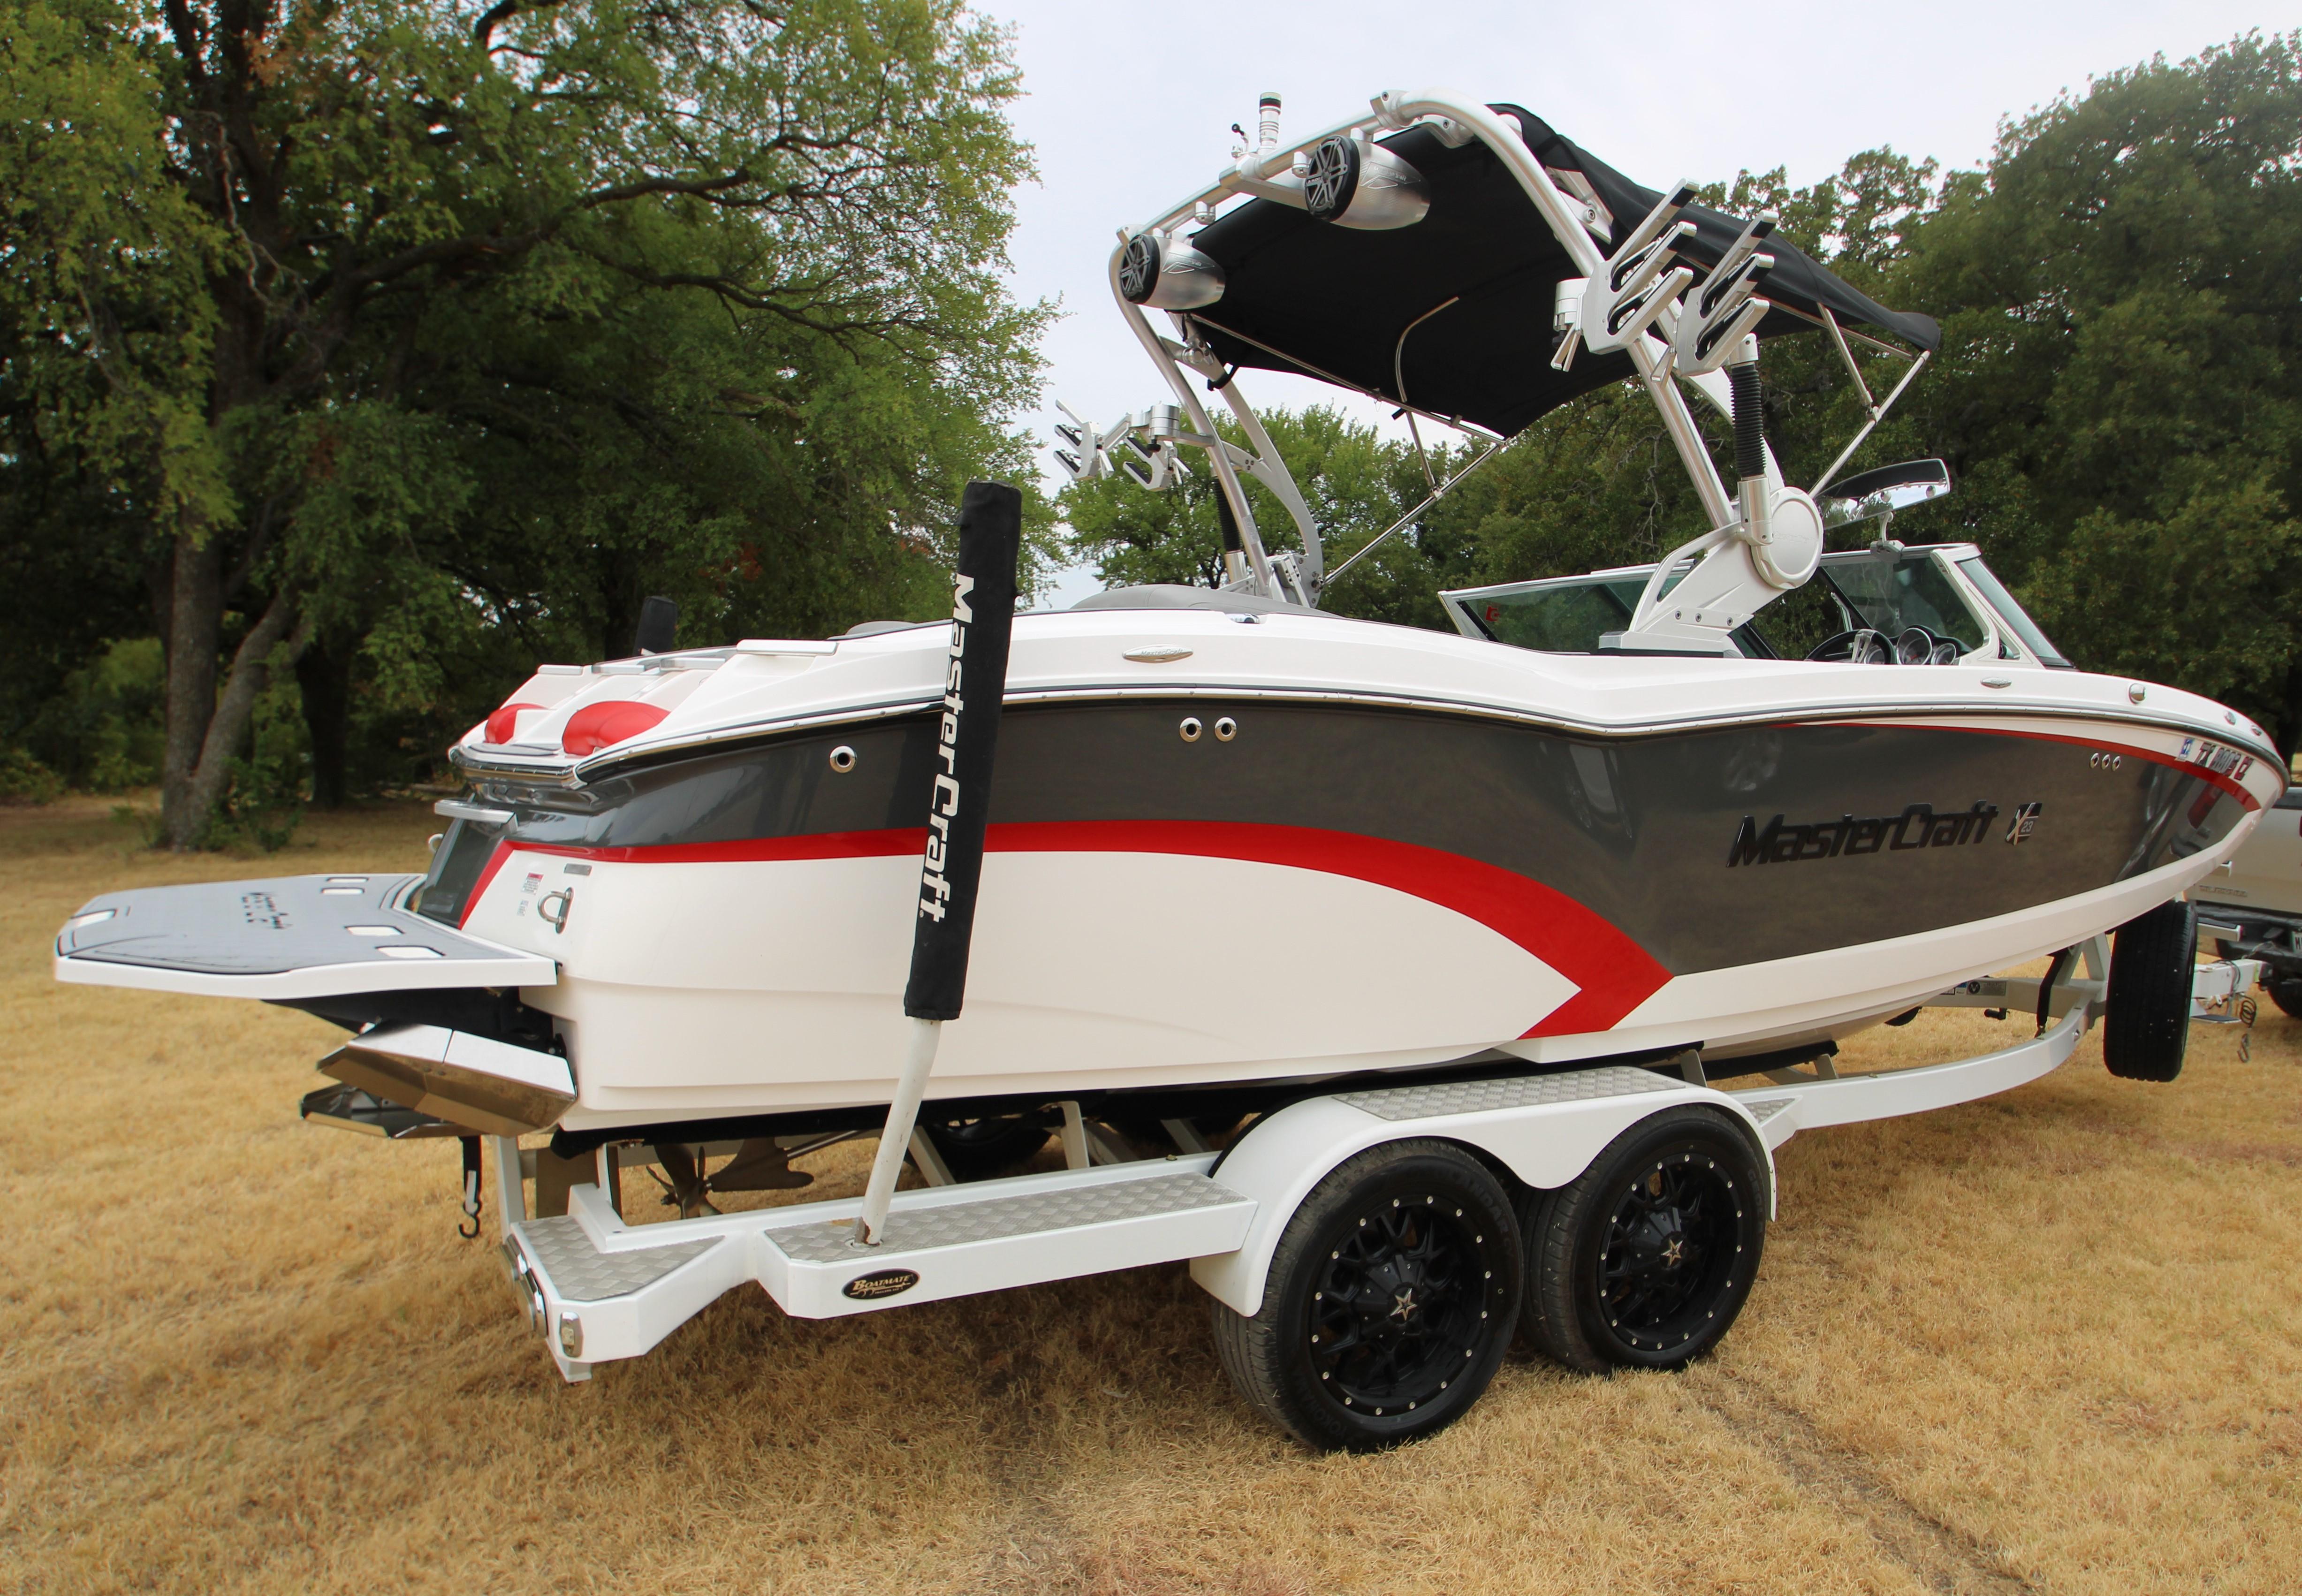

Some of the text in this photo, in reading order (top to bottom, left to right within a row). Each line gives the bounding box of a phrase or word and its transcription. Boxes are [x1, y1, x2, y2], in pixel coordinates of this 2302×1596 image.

[919, 573, 974, 923] MasterCraft
[1725, 799, 1999, 868] MasterCraft
[852, 1275, 911, 1291] BOATMATE
